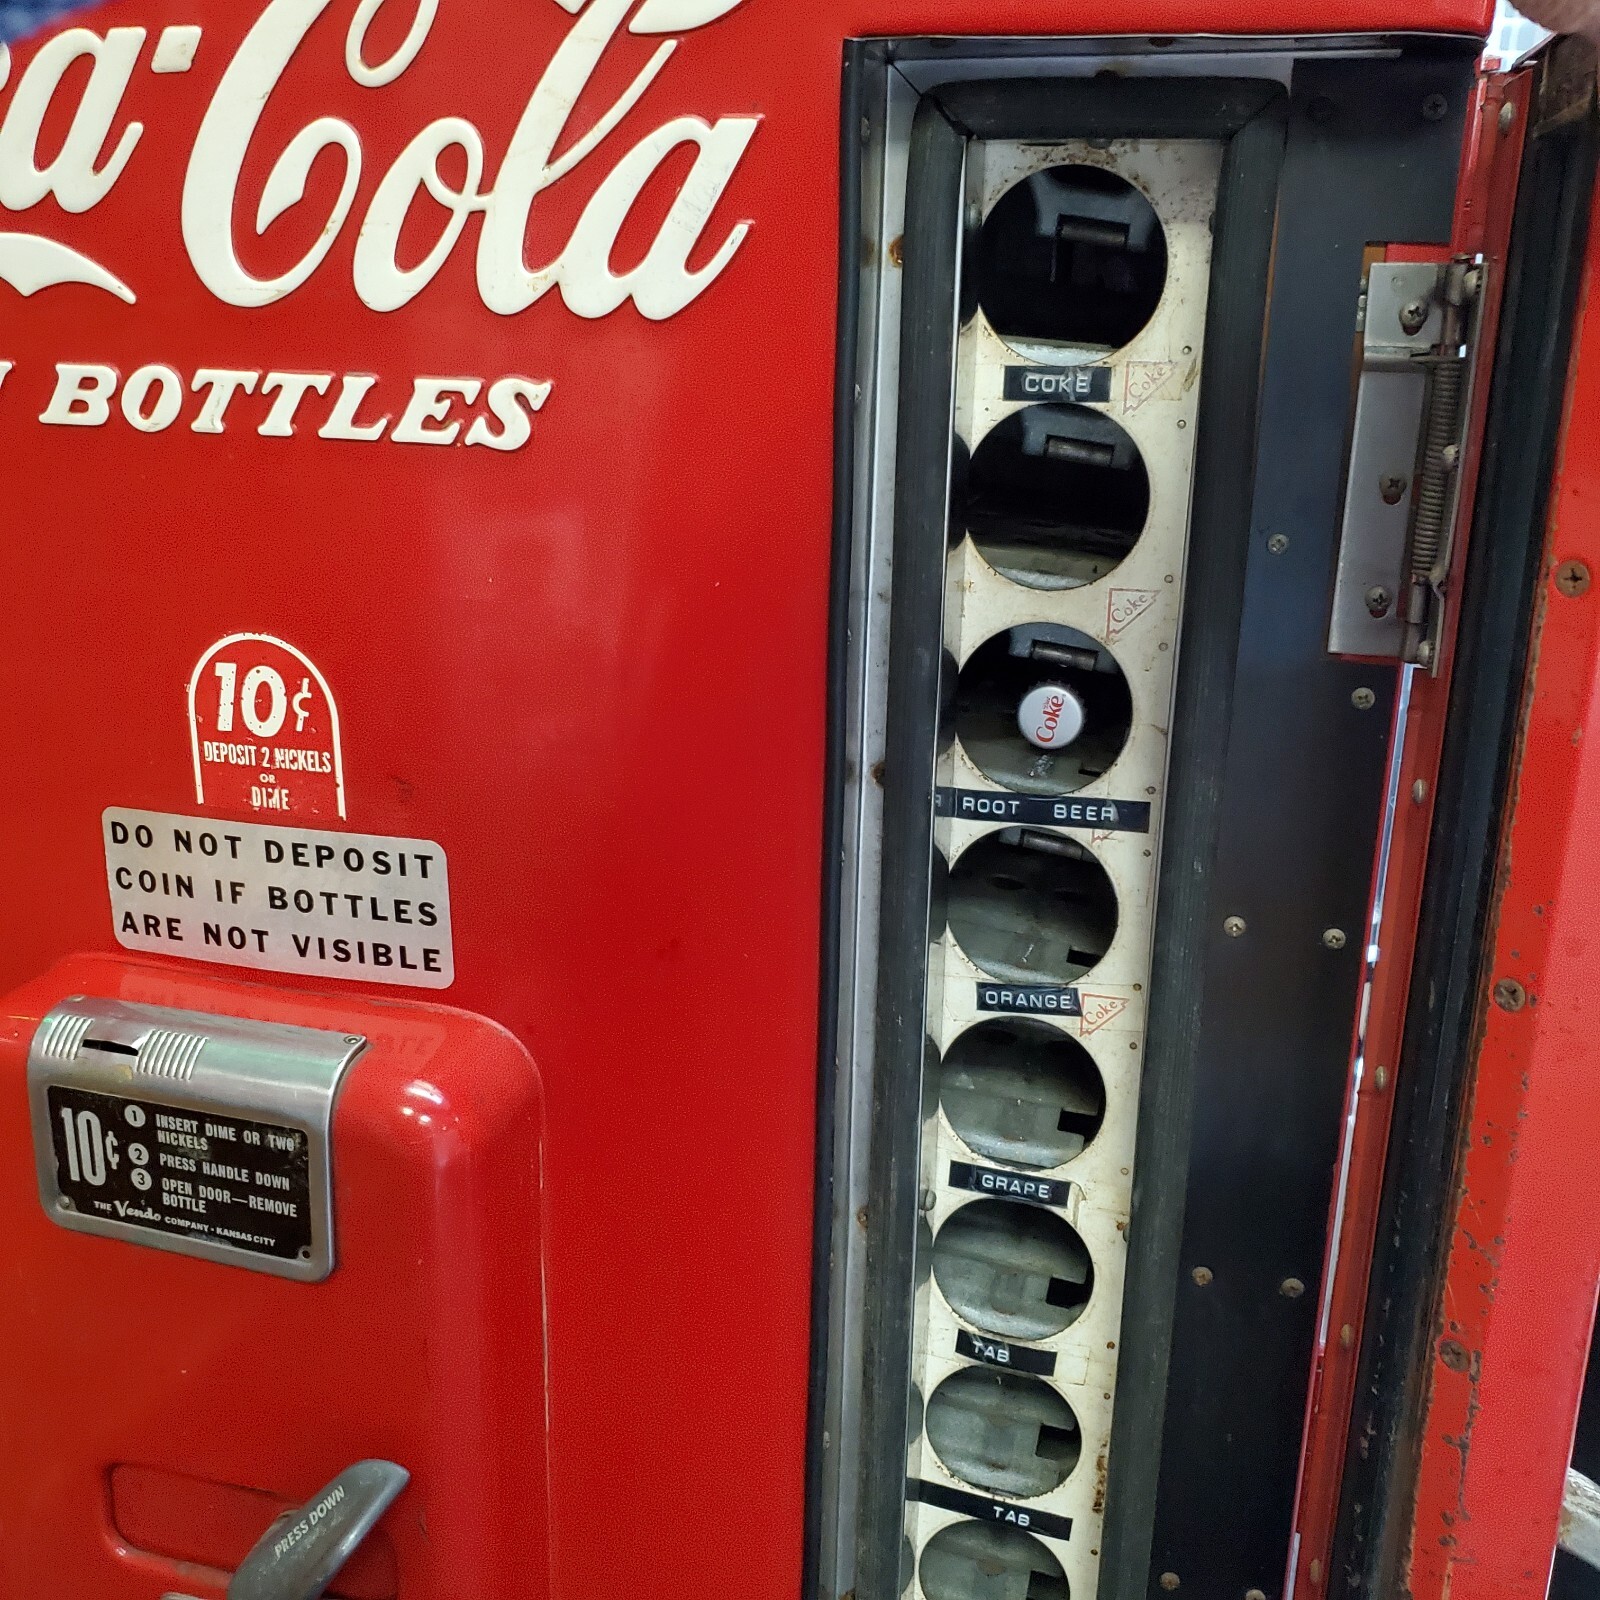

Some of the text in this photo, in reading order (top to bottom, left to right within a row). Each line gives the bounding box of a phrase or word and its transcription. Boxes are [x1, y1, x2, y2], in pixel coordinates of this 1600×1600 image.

[0, 0, 764, 320] a-Cola
[1024, 375, 1090, 393] COKE
[1128, 366, 1165, 399] Coke
[38, 361, 553, 451] BOTTLES
[1111, 593, 1148, 623] Coke
[1036, 696, 1064, 743] Coke
[203, 741, 332, 773] DEPOSIT 2 NICKELS
[259, 774, 276, 783] OR
[251, 786, 290, 810] DIME
[963, 797, 1114, 821] ROOT BEER
[111, 821, 433, 878] DO NOT DEPOSIT
[115, 867, 438, 926] COIN IF BOTTLES
[121, 911, 442, 972] ARE NOT VISIBLE
[985, 991, 1072, 1009] ORANGE
[1084, 999, 1118, 1025] Coke
[61, 1106, 120, 1186] 10¢
[155, 1113, 295, 1152] INSERT DIME OR TWO
[157, 1129, 208, 1151] NICKELS
[159, 1152, 291, 1191] PRESS HANDLE DOWN
[161, 1177, 193, 1196] OPEN
[981, 1174, 1050, 1198] GRAPE
[162, 1191, 207, 1214] BOTTLE
[93, 1200, 276, 1247] THE Vendo COMPANY KANSAS CITY
[972, 1340, 1010, 1363] TAB
[274, 1484, 345, 1562] PRESS DOWN
[993, 1505, 1030, 1526] TAB
